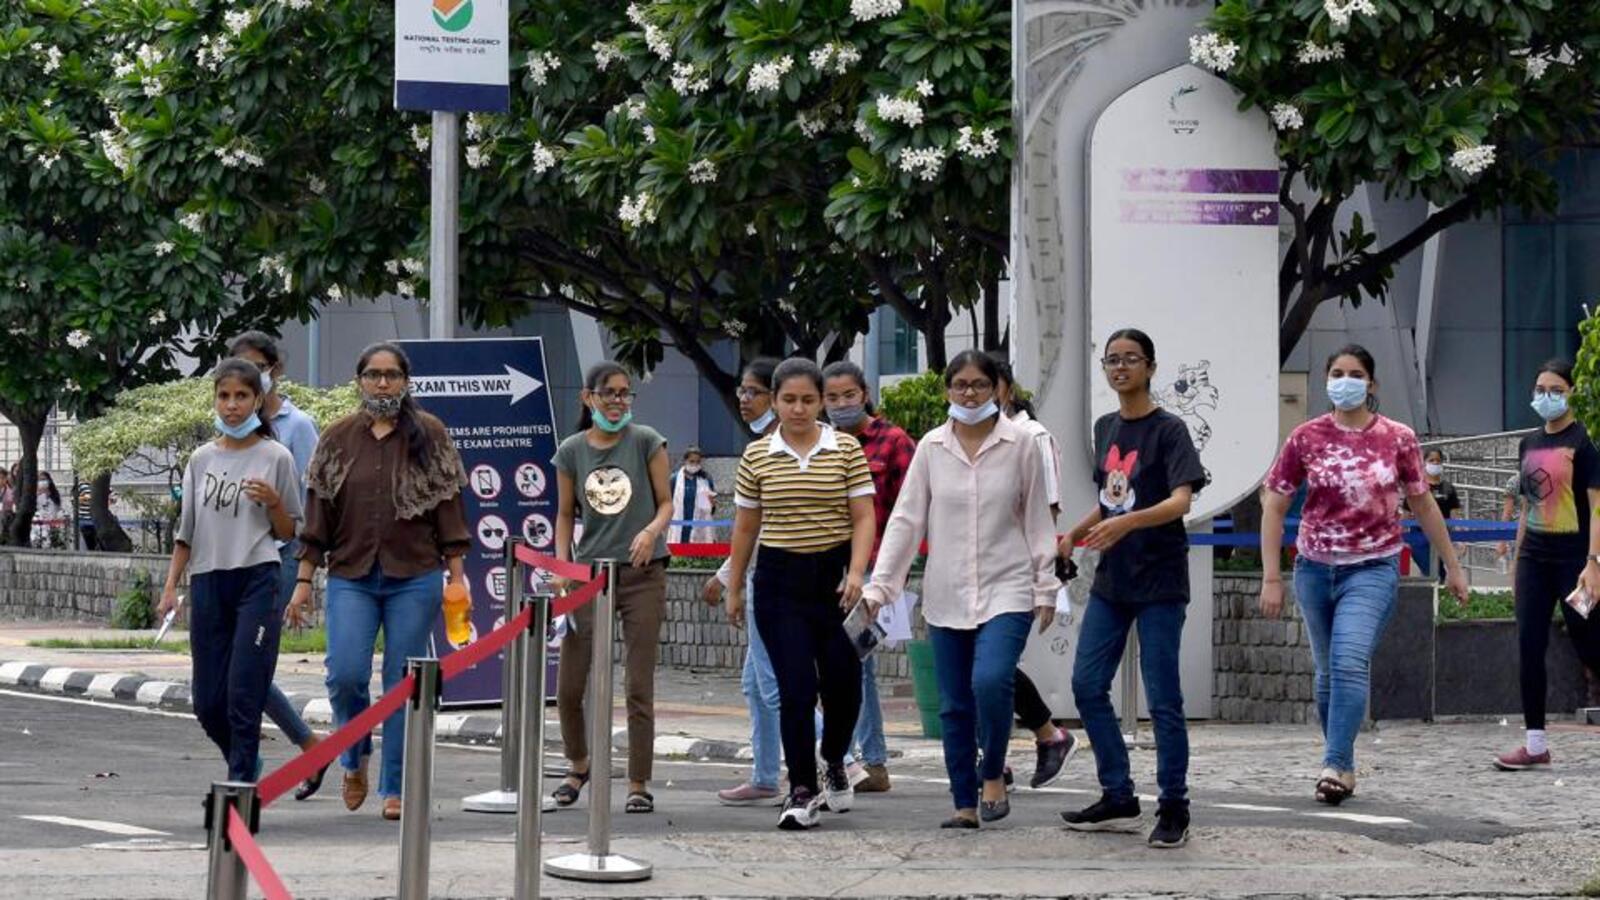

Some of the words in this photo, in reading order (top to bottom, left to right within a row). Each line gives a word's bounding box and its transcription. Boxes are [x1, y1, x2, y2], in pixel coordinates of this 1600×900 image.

[442, 36, 469, 44] TESTING
[472, 38, 500, 46] AGENCY
[447, 379, 481, 393] THIS
[481, 378, 511, 392] WAY
[471, 426, 492, 437] ARE
[493, 425, 551, 435] PROHIBITED
[463, 438, 493, 450] EXAM
[494, 438, 533, 448] CENTRE
